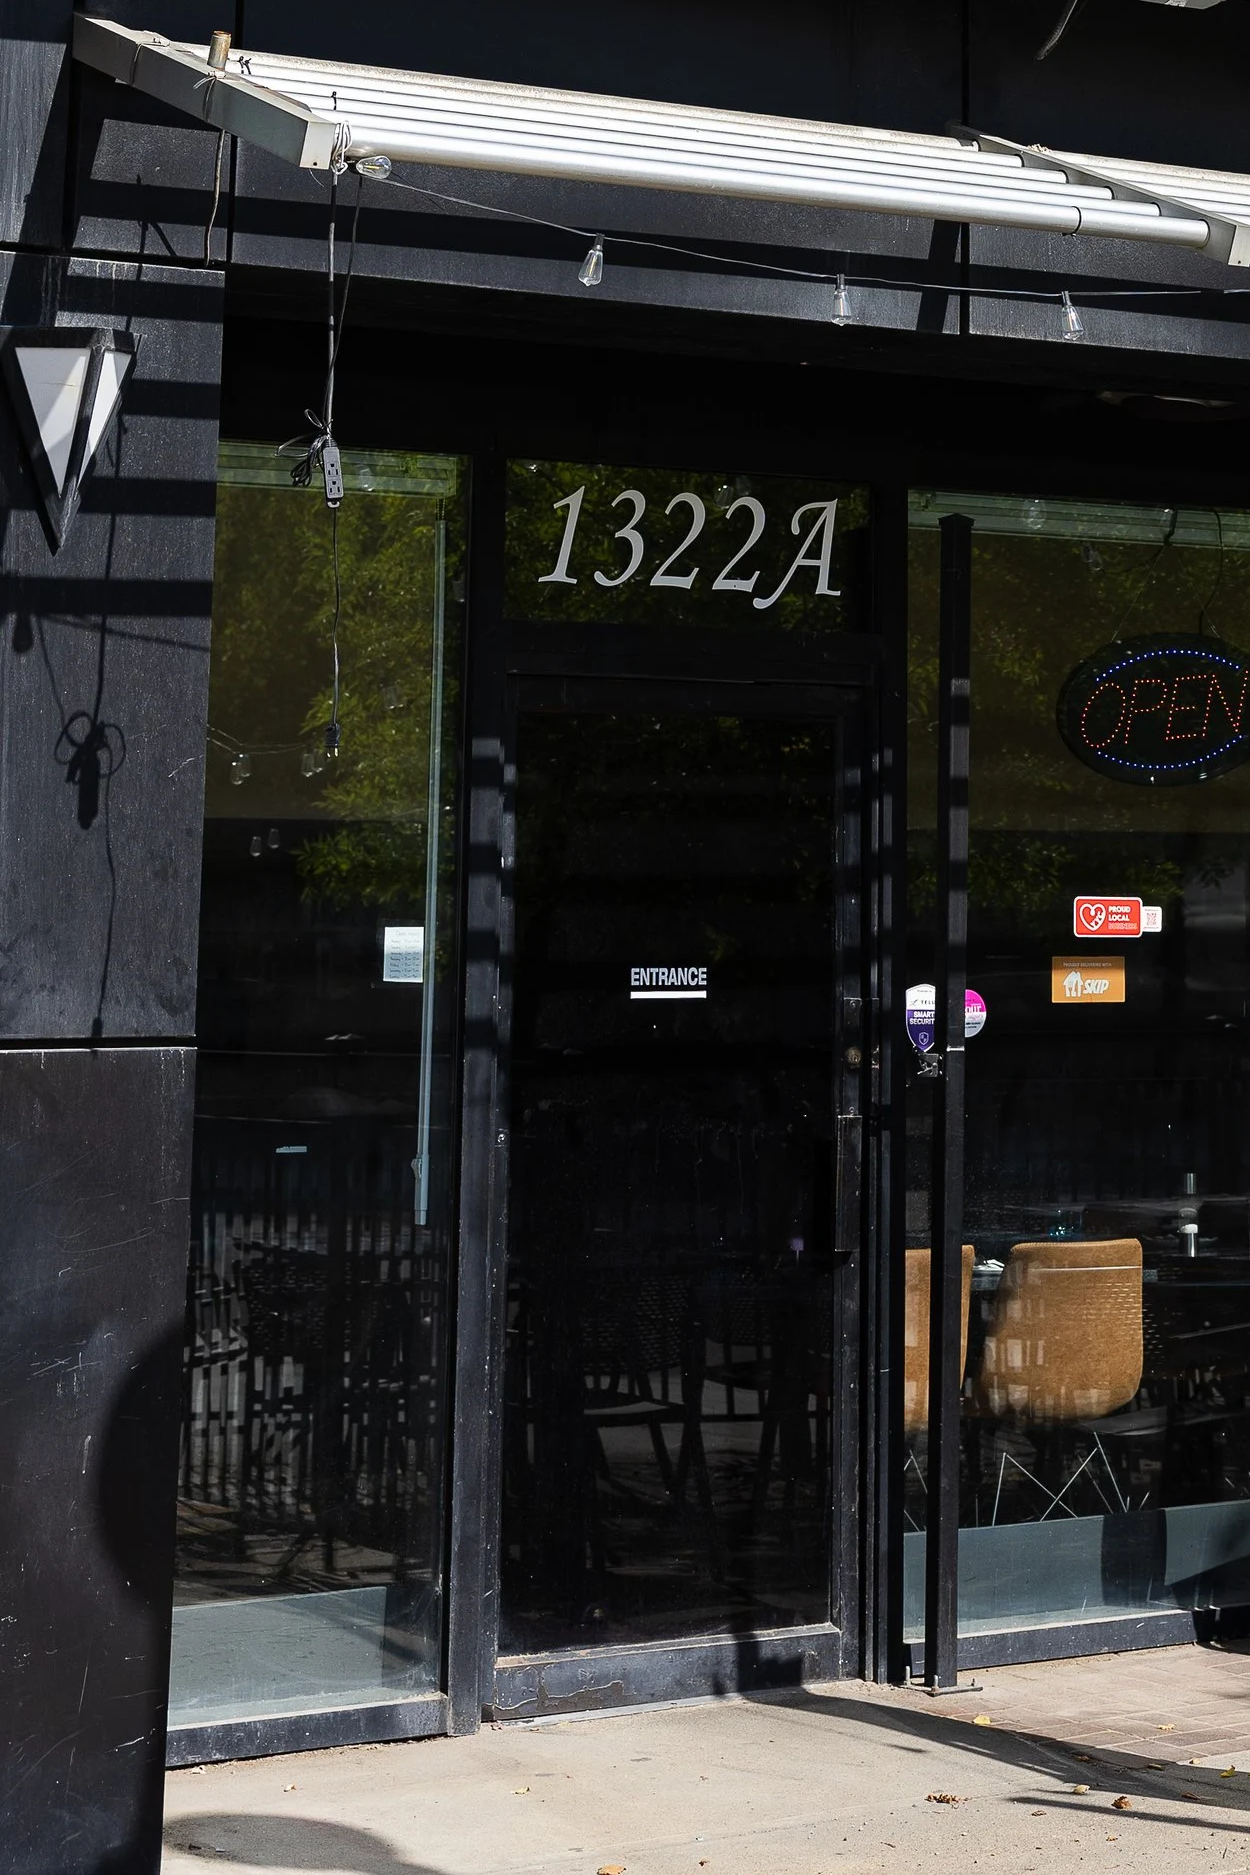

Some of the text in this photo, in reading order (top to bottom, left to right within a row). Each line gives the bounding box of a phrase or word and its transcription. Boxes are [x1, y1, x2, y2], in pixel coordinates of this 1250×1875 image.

[537, 485, 842, 610] 1322A
[1079, 669, 1249, 749] OPEN
[1108, 914, 1130, 922] LOCAL
[631, 967, 707, 986] ENTRANCE
[1083, 979, 1109, 994] SKIP
